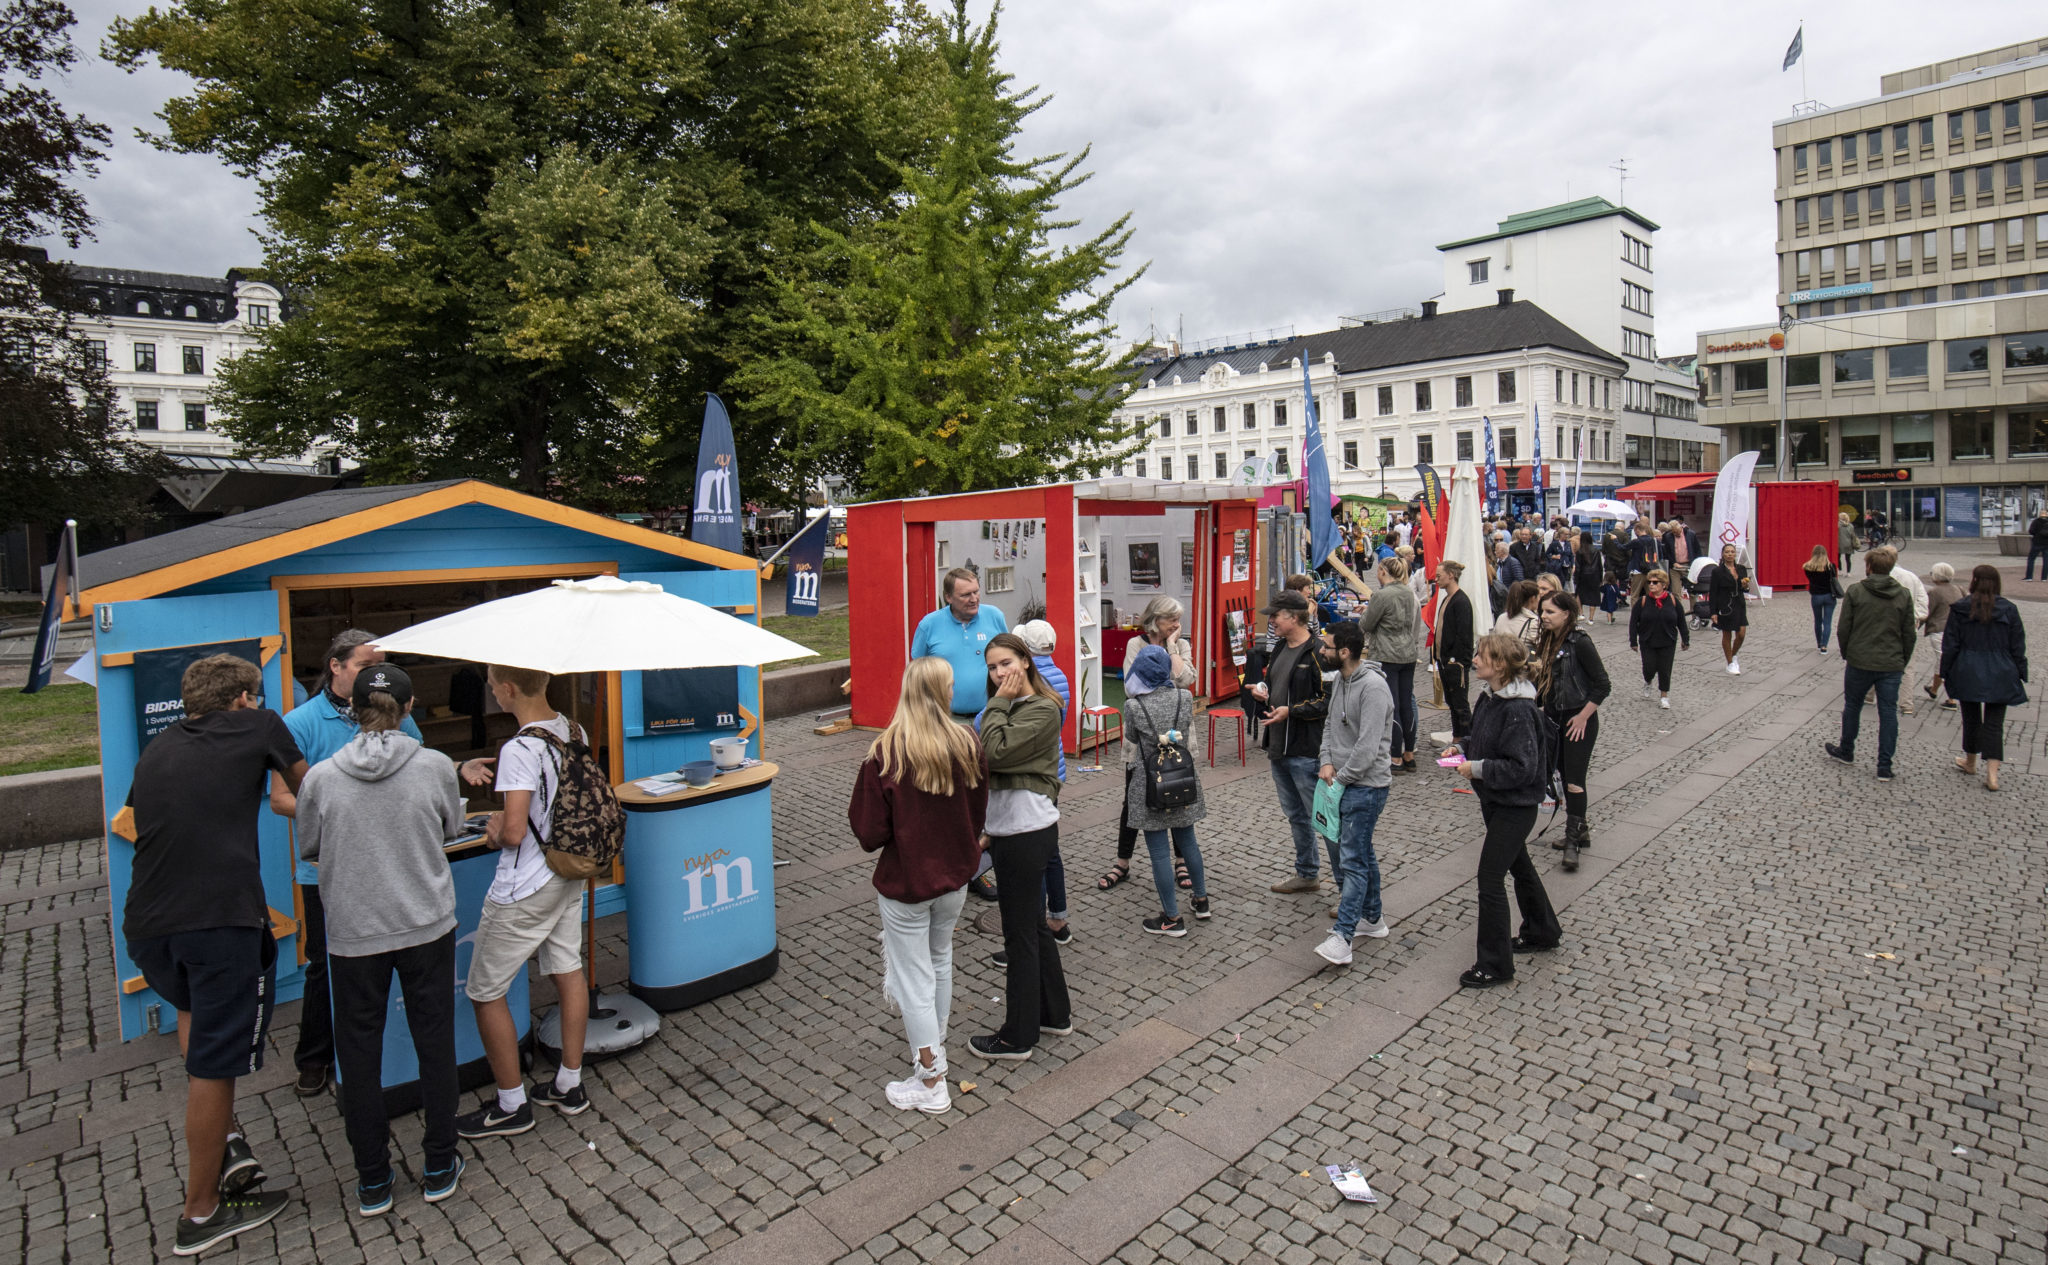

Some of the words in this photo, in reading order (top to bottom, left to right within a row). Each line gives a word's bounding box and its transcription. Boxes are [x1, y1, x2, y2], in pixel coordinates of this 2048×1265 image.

[1791, 292, 1811, 301] TRR
[1707, 339, 1766, 354] Swedbank
[1520, 505, 1531, 513] SD
[793, 571, 818, 600] m
[150, 714, 178, 724] Sverige
[684, 848, 731, 877] nya
[682, 856, 759, 916] m
